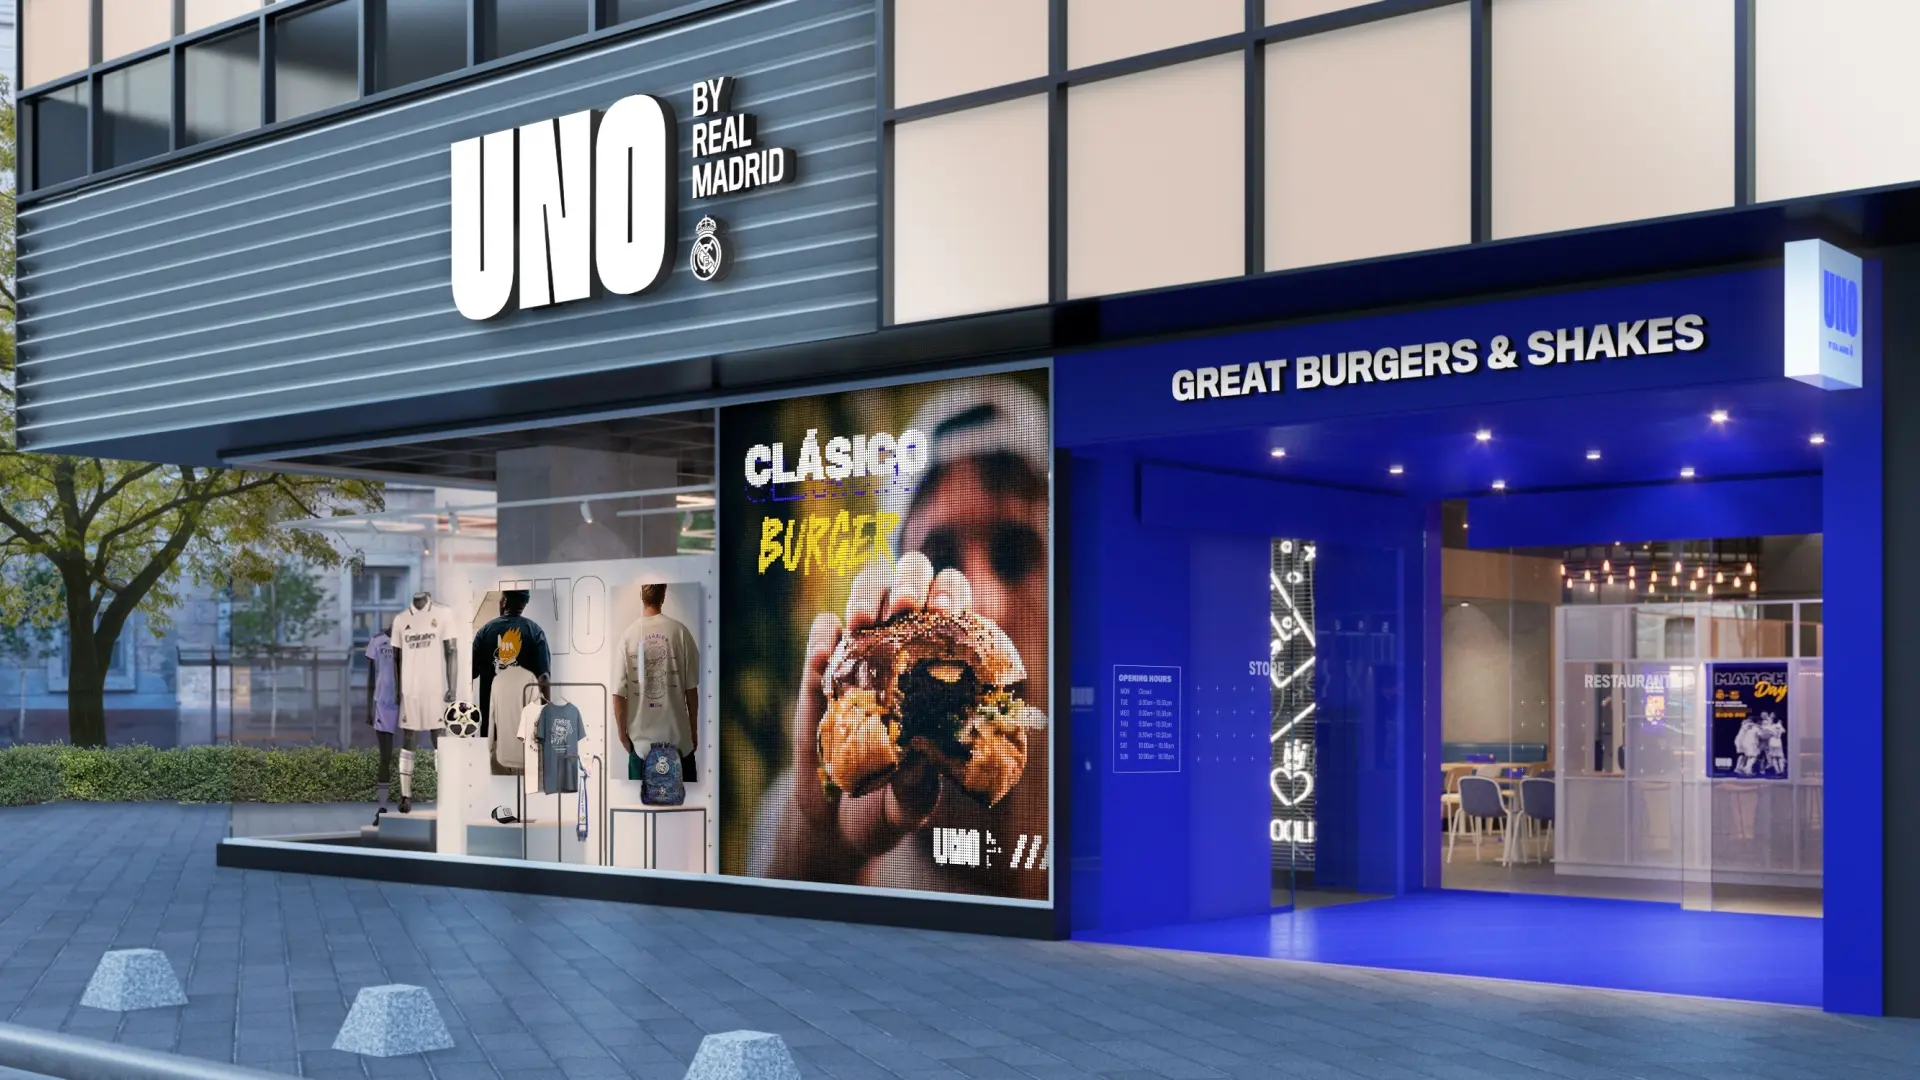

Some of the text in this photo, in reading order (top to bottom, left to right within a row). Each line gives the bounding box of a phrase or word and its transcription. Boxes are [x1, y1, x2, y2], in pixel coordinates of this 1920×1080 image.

[693, 76, 725, 117] BY
[693, 113, 752, 158] REAL
[692, 147, 784, 199] MADRID
[451, 94, 666, 320] UNO
[1823, 269, 1858, 338] UNO
[1171, 313, 1705, 402] GREAT BURGERS & SHAKES
[745, 429, 928, 487] CLÁSICO
[758, 509, 901, 576] BURGER
[1118, 674, 1172, 683] OPENING HOURS
[1249, 660, 1285, 676] STORE
[1584, 674, 1671, 688] RESTAURANT
[1714, 672, 1788, 685] MATCH
[1754, 681, 1789, 703] Day
